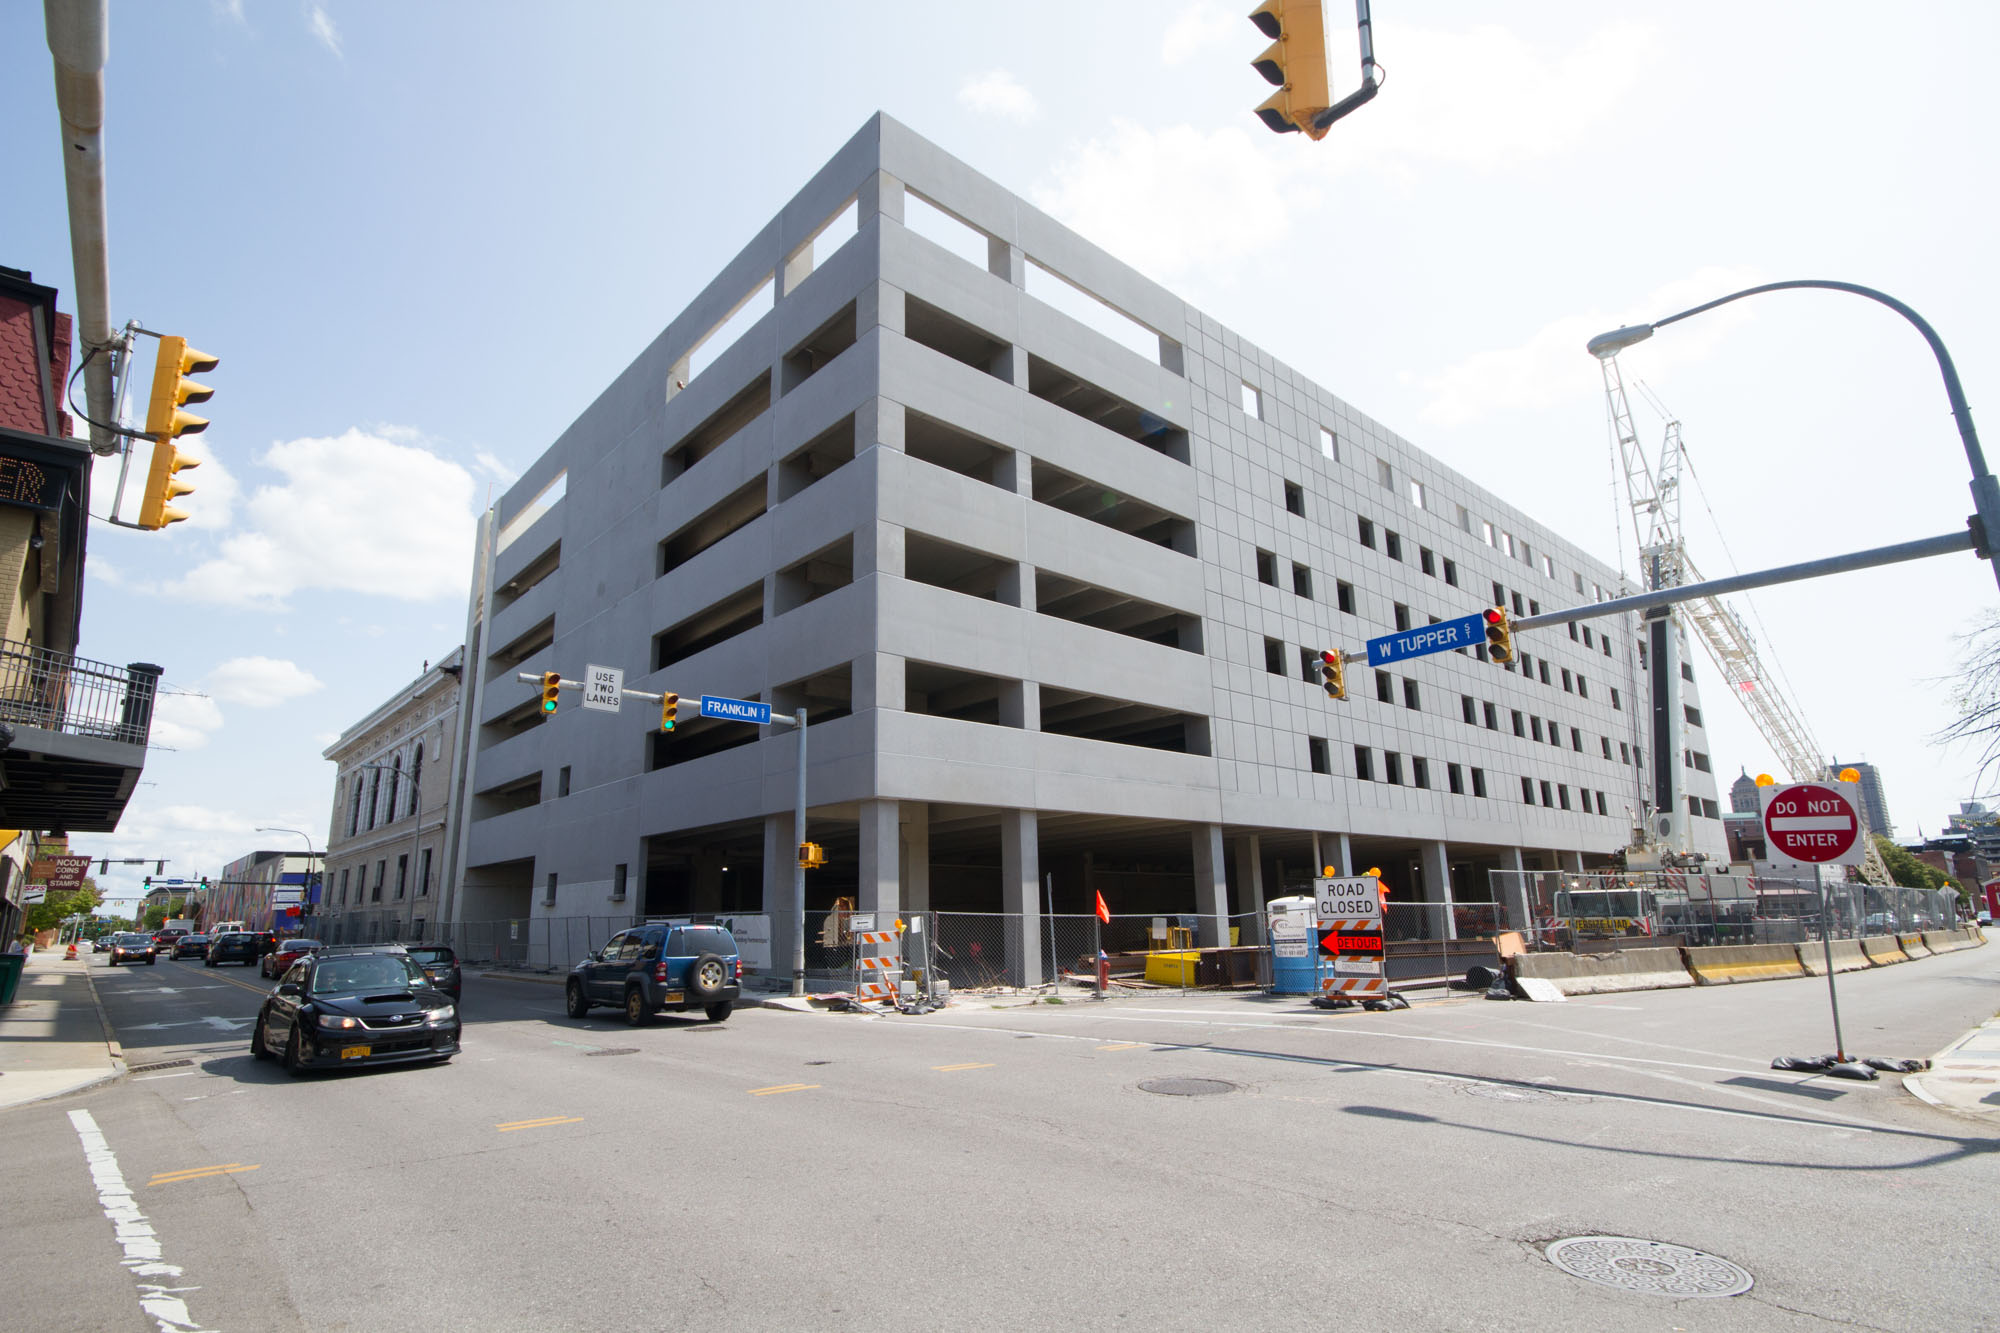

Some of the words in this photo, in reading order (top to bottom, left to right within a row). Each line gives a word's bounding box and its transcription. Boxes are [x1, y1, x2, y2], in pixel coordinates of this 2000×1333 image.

[1379, 642, 1391, 658] W
[1397, 627, 1458, 653] TUPPER
[1464, 623, 1471, 639] ST
[595, 672, 615, 683] USE
[594, 683, 614, 694] TWO
[586, 693, 619, 706] LANES
[707, 701, 757, 718] FRANKLIN
[1776, 801, 1797, 814] DO
[1807, 800, 1841, 813] NOT
[1786, 833, 1839, 847] ENTER
[55, 858, 89, 868] NCOLN
[1327, 883, 1365, 897] ROAD
[1321, 900, 1373, 914] CLOSED
[1337, 937, 1379, 949] DETOUR
